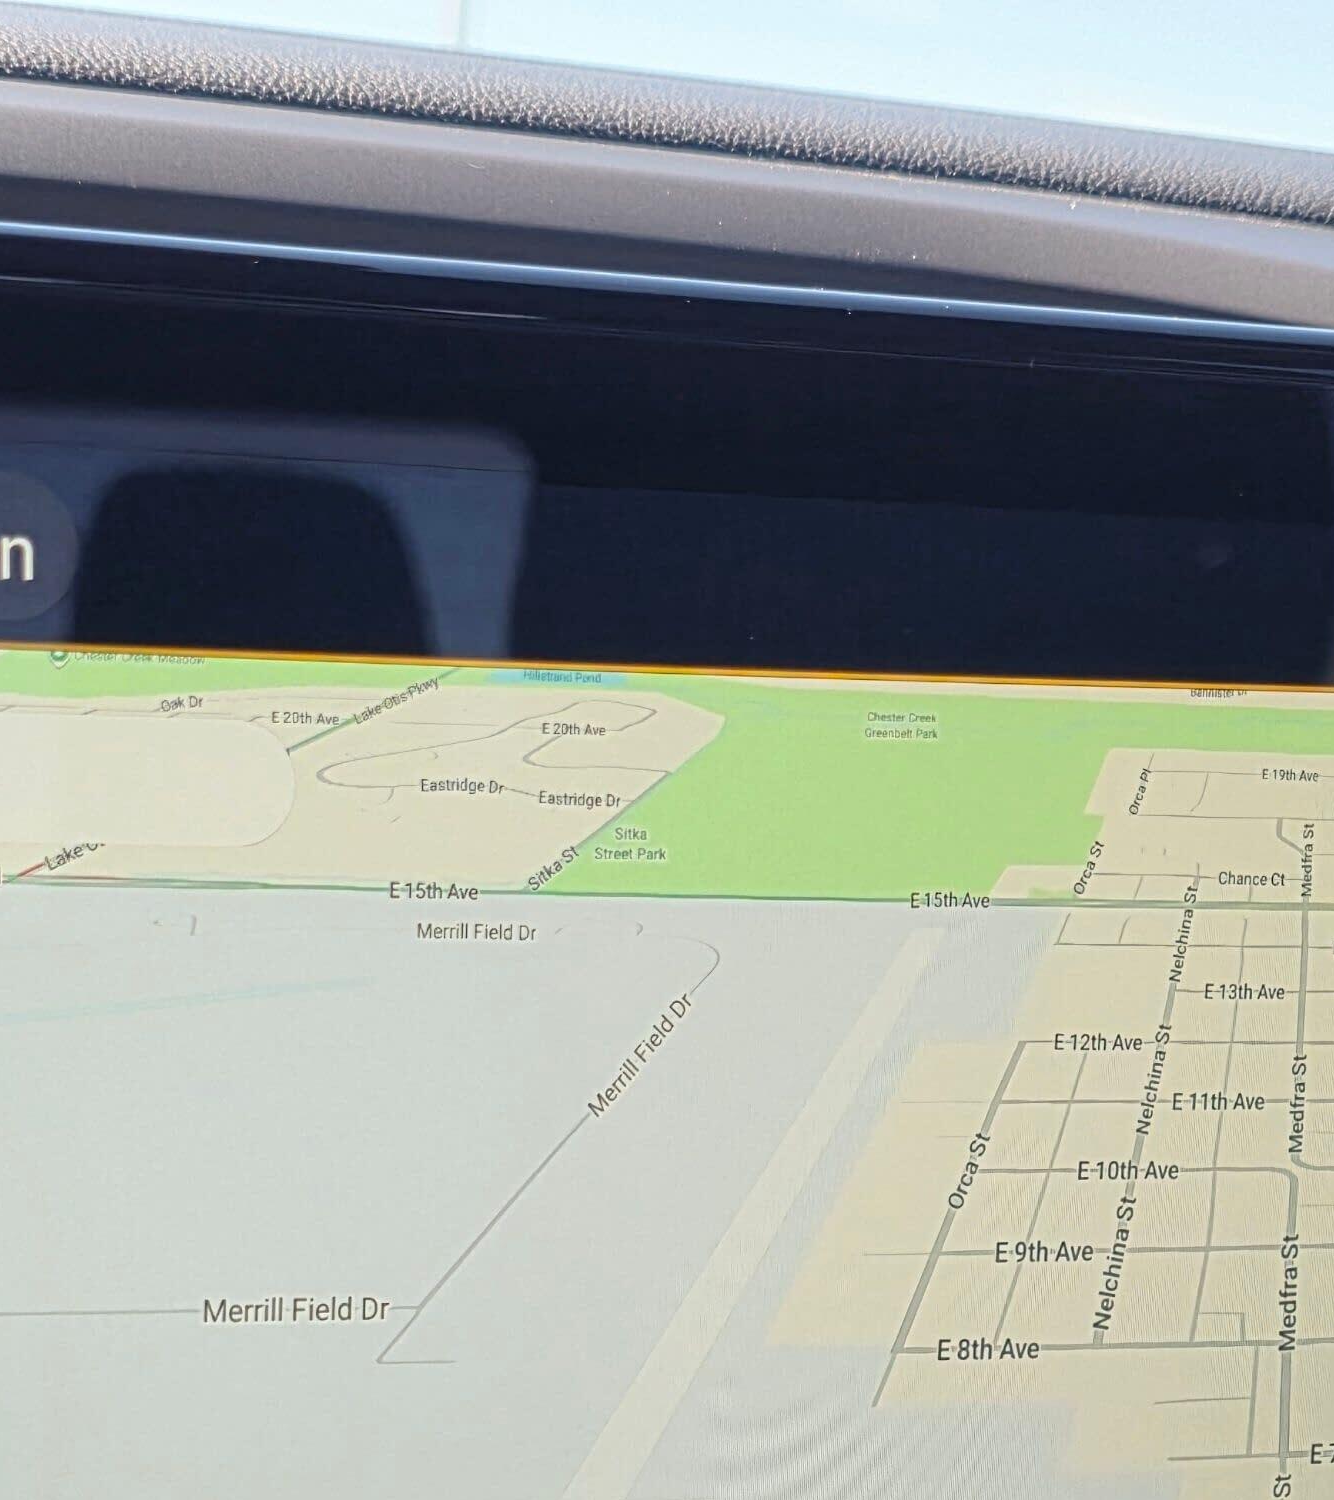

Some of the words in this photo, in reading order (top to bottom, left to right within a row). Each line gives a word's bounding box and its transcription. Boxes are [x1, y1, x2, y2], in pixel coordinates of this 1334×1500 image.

[161, 697, 184, 712] Oak
[189, 696, 204, 708] Dr
[271, 712, 280, 724] E
[283, 711, 312, 725] 20th
[315, 713, 340, 726] Ave
[867, 712, 906, 724] Chester
[908, 713, 937, 724] Creek
[541, 723, 550, 735] E
[552, 723, 581, 736] 20th
[583, 724, 606, 737] Ave
[864, 727, 913, 740] Greenbelt
[915, 728, 938, 740] Park
[1262, 769, 1269, 781] E
[1273, 769, 1296, 782] 19th
[1298, 770, 1319, 783] Ave
[420, 778, 486, 798] Eastridge
[488, 779, 505, 794] Dr
[539, 791, 602, 810] Eastridge
[605, 793, 621, 808] Dr
[614, 827, 647, 842] Sitka
[45, 847, 84, 870] Lake
[595, 847, 633, 862] Street
[636, 847, 666, 861] Park
[528, 857, 564, 892] Sitka
[562, 845, 580, 867] St
[1074, 861, 1095, 895] Orca
[1090, 841, 1105, 858] St
[1218, 871, 1267, 887] Chance
[1270, 871, 1285, 887] Ct
[389, 882, 400, 900] E
[405, 882, 442, 901] 15th
[446, 883, 479, 902] Ave
[911, 893, 920, 909] E
[924, 892, 958, 909] 15th
[962, 893, 990, 909] Ave
[417, 922, 469, 941] Merrill
[474, 922, 514, 941] Field
[518, 924, 537, 942] Dr
[1169, 909, 1194, 982] Nelchina
[1184, 886, 1198, 903] St
[1204, 984, 1214, 999] E
[1219, 984, 1253, 1000] 13th
[1258, 985, 1285, 1000] Ave
[1054, 1034, 1064, 1050] E
[1071, 1034, 1106, 1051] 12th
[1112, 1035, 1142, 1051] Ave
[587, 1059, 639, 1118] Merrill
[634, 1014, 677, 1065] Field
[669, 992, 693, 1021] Dr
[1292, 1054, 1308, 1077] St
[1136, 1051, 1167, 1135] Nelchina
[1155, 1024, 1173, 1045] St
[1172, 1093, 1182, 1111] E
[1190, 1093, 1227, 1110] 11th
[1233, 1093, 1265, 1111] Ave
[1288, 1082, 1306, 1153] Medfra
[948, 1164, 979, 1209] Orca
[970, 1132, 991, 1157] St
[1078, 1161, 1089, 1180] E
[1096, 1160, 1138, 1180] 10th
[1144, 1161, 1179, 1180] Ave
[995, 1242, 1008, 1263] E
[1014, 1240, 1048, 1262] 9th
[1055, 1241, 1093, 1262] Ave
[1281, 1234, 1299, 1259] St
[1093, 1228, 1129, 1330] Nelchina
[1117, 1196, 1137, 1222] St
[203, 1296, 285, 1325] Merrill
[292, 1295, 354, 1324] Field
[360, 1295, 390, 1322] Dr
[1278, 1268, 1298, 1351] Medfra
[937, 1339, 951, 1361] E
[957, 1338, 993, 1361] 8th
[999, 1338, 1039, 1360] Ave
[1310, 1444, 1322, 1464] E
